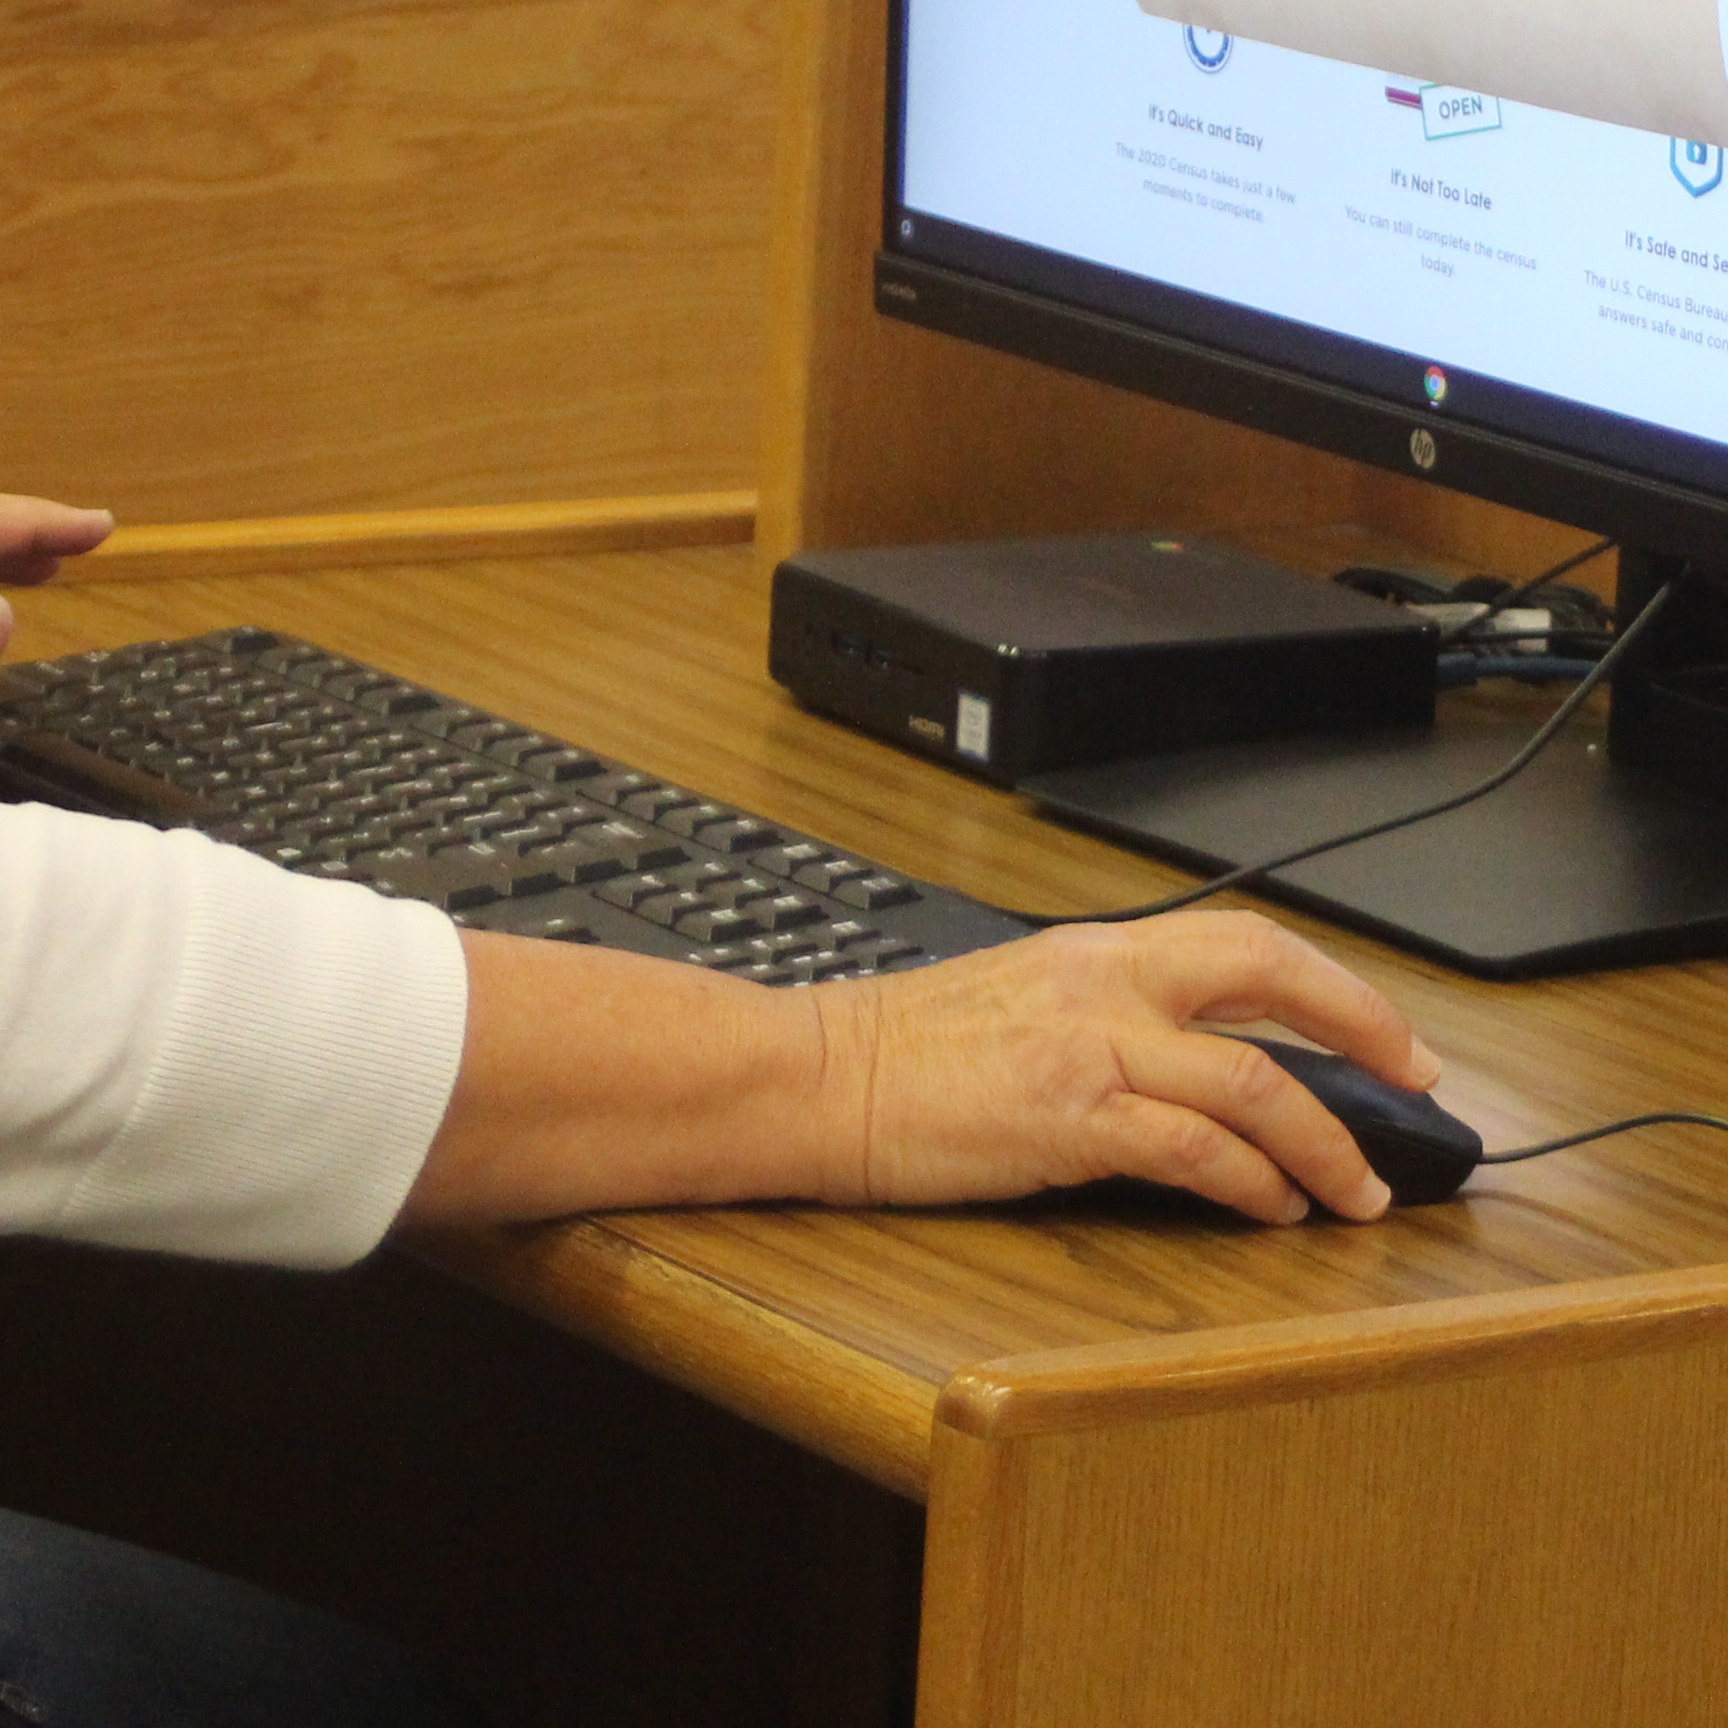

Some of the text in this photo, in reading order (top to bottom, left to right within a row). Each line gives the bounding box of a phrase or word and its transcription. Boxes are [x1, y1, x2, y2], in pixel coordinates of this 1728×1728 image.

[1148, 103, 1264, 151] It's Quick and Easy
[1438, 94, 1484, 120] OPEN
[1115, 142, 1297, 204] The 2020 Census takes just a few
[1390, 168, 1493, 210] It's Not Too Late
[1142, 178, 1265, 223] moments to complete.
[1345, 204, 1538, 270] You can still complete the census
[1625, 229, 1643, 250] It's
[1647, 235, 1677, 260] Safe
[1681, 246, 1709, 269] and
[1420, 253, 1456, 278] today.
[1584, 269, 1607, 289] The
[1609, 278, 1633, 297] U.S.
[1636, 284, 1682, 310] Census
[1684, 297, 1728, 324] Bureau
[1598, 303, 1648, 330] answers
[1650, 317, 1677, 338] safe
[1679, 326, 1704, 346] and
[1411, 428, 1436, 468] hp
